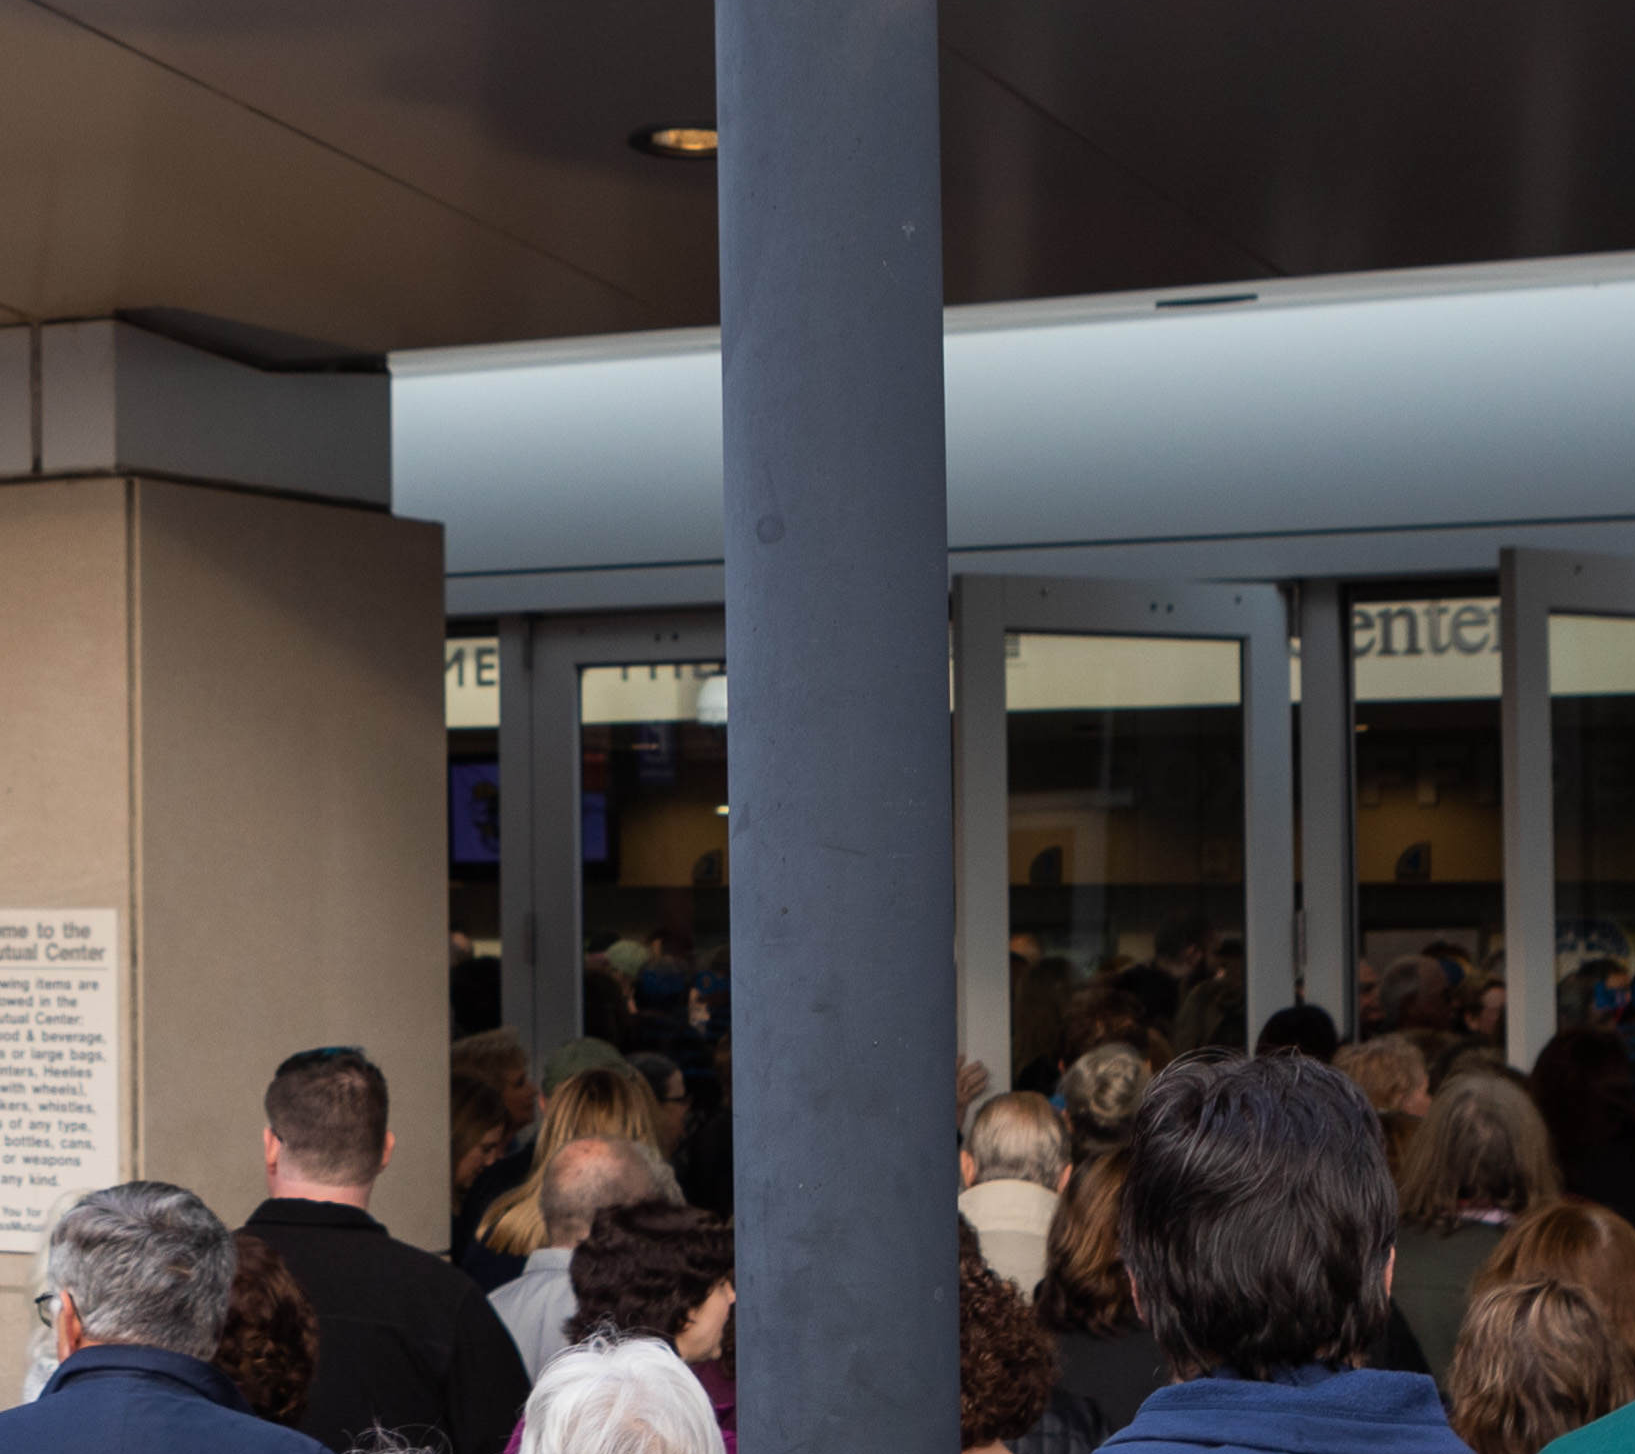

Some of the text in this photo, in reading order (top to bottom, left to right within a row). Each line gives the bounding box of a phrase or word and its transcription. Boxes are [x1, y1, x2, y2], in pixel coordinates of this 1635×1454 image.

[36, 922, 55, 940] to
[62, 921, 91, 940] the
[44, 942, 105, 962] Center
[35, 978, 72, 991] items
[78, 980, 99, 991] are
[39, 997, 51, 1007] in
[57, 996, 78, 1008] the
[11, 1049, 25, 1060] or
[30, 1048, 64, 1064] large
[0, 1082, 26, 1094] with
[9, 1118, 22, 1130] of
[28, 1120, 51, 1133] any
[3, 1154, 16, 1164] or
[22, 1155, 81, 1167] weapons
[0, 1175, 23, 1188] any
